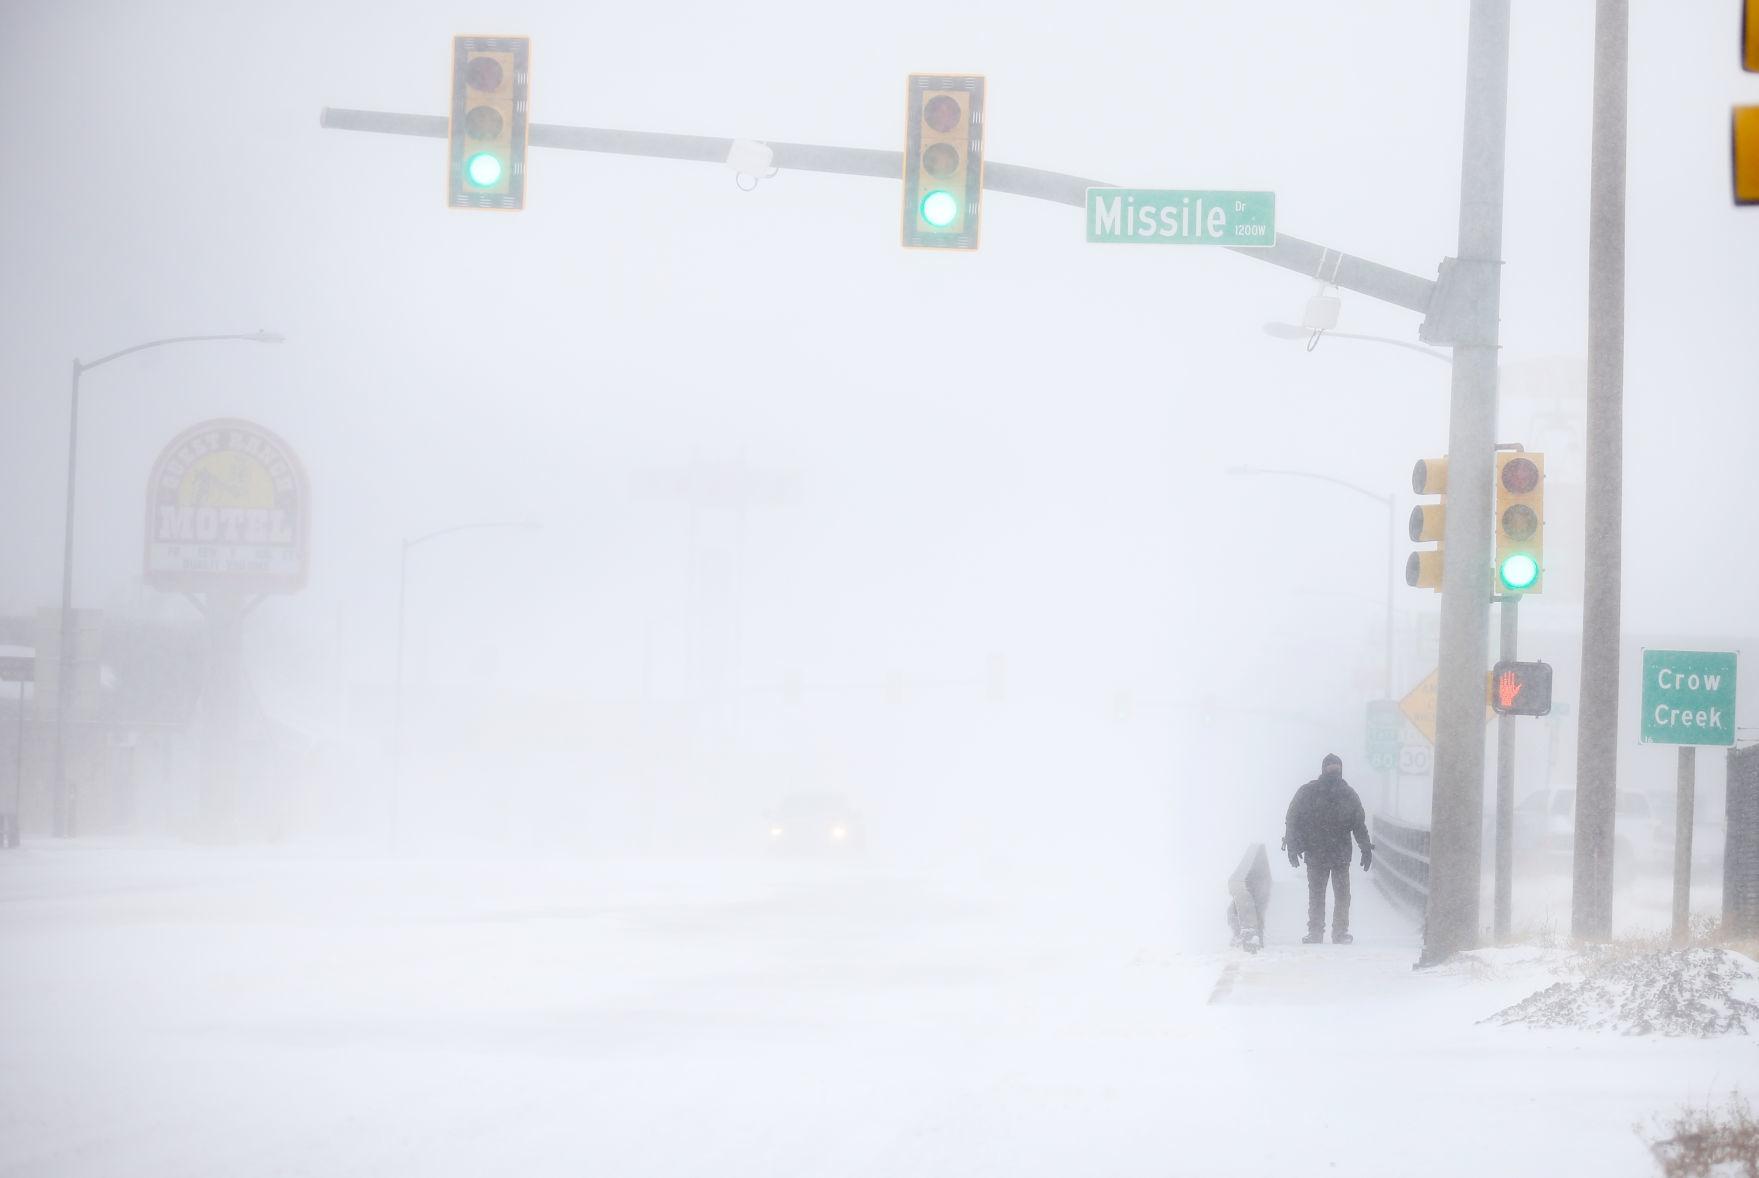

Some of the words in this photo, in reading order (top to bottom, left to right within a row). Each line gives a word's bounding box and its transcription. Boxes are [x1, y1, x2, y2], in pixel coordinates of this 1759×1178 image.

[1095, 196, 1227, 238] Missile
[1235, 200, 1246, 212] Dr
[1235, 224, 1266, 236] 1200W
[161, 431, 221, 489] GUEST
[158, 505, 293, 542] MOTEL
[1658, 668, 1721, 691] Crow
[1654, 704, 1722, 728] Creek
[1402, 752, 1427, 768] 30
